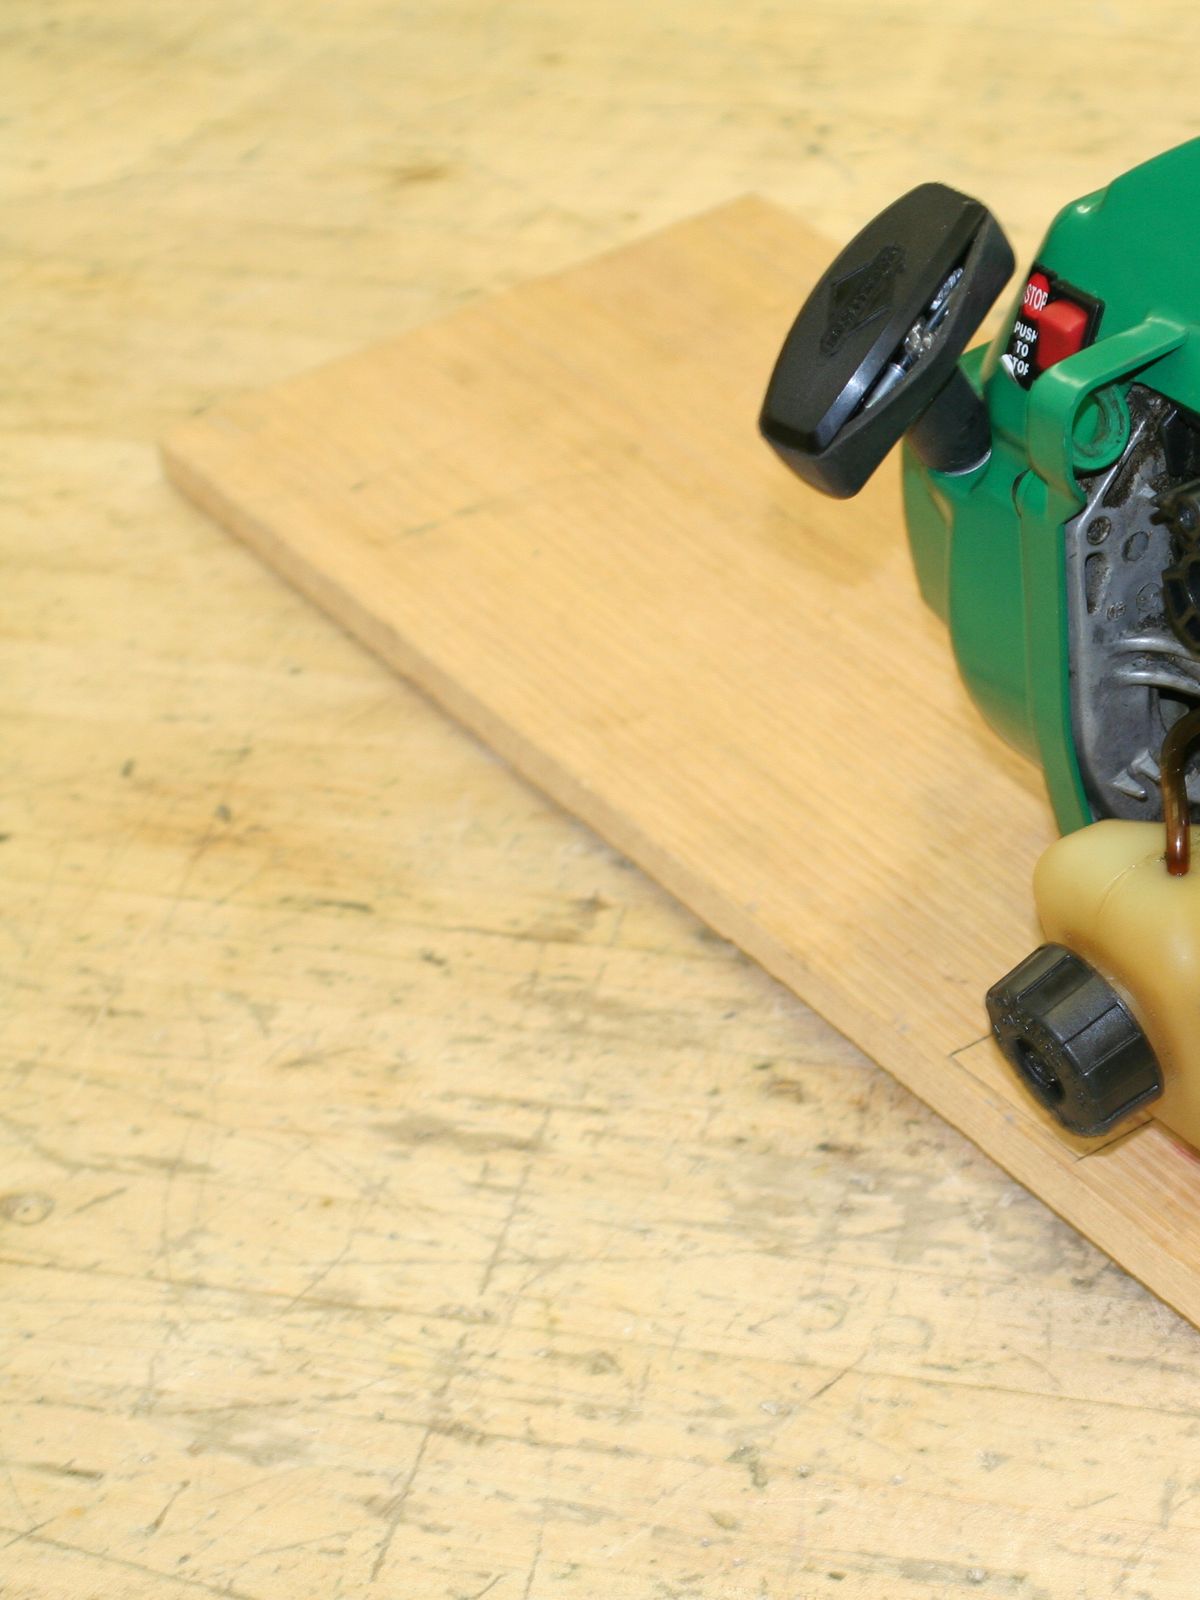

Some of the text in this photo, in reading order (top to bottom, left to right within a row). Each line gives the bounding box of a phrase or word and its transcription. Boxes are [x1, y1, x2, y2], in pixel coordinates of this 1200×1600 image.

[1024, 284, 1048, 311] STOP
[1014, 321, 1037, 343] PUSH
[1016, 340, 1028, 357] TO
